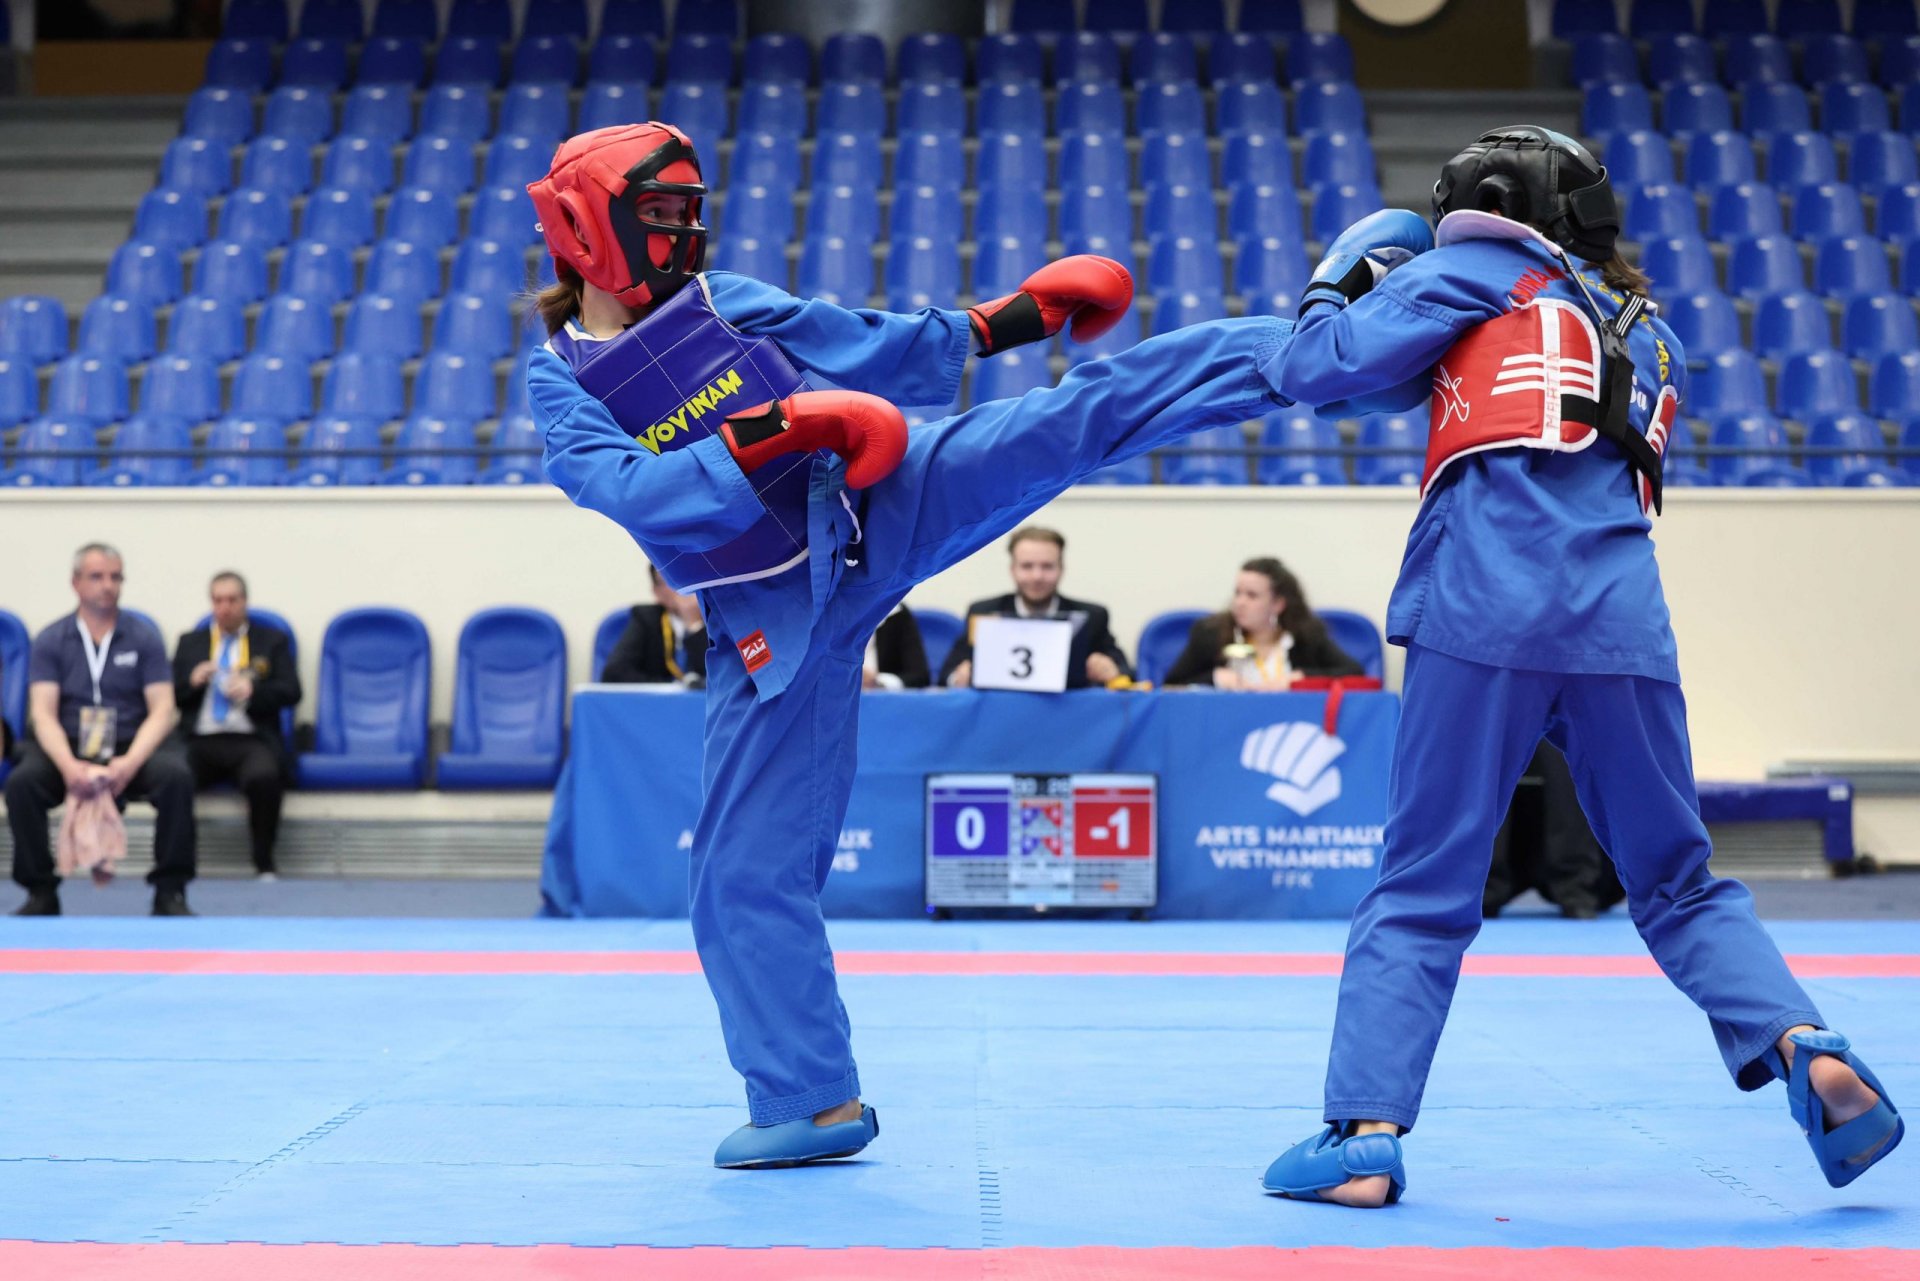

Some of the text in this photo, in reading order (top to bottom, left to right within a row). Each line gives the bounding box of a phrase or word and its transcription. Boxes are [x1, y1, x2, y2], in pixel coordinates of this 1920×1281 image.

[636, 369, 743, 456] VOVINAM
[1010, 647, 1032, 679] 3
[955, 806, 986, 851] 0
[1089, 806, 1130, 850] -1
[1196, 825, 1261, 847] ARTS
[1210, 848, 1376, 870] VIETNAMIENS
[1271, 871, 1314, 889] FFK
